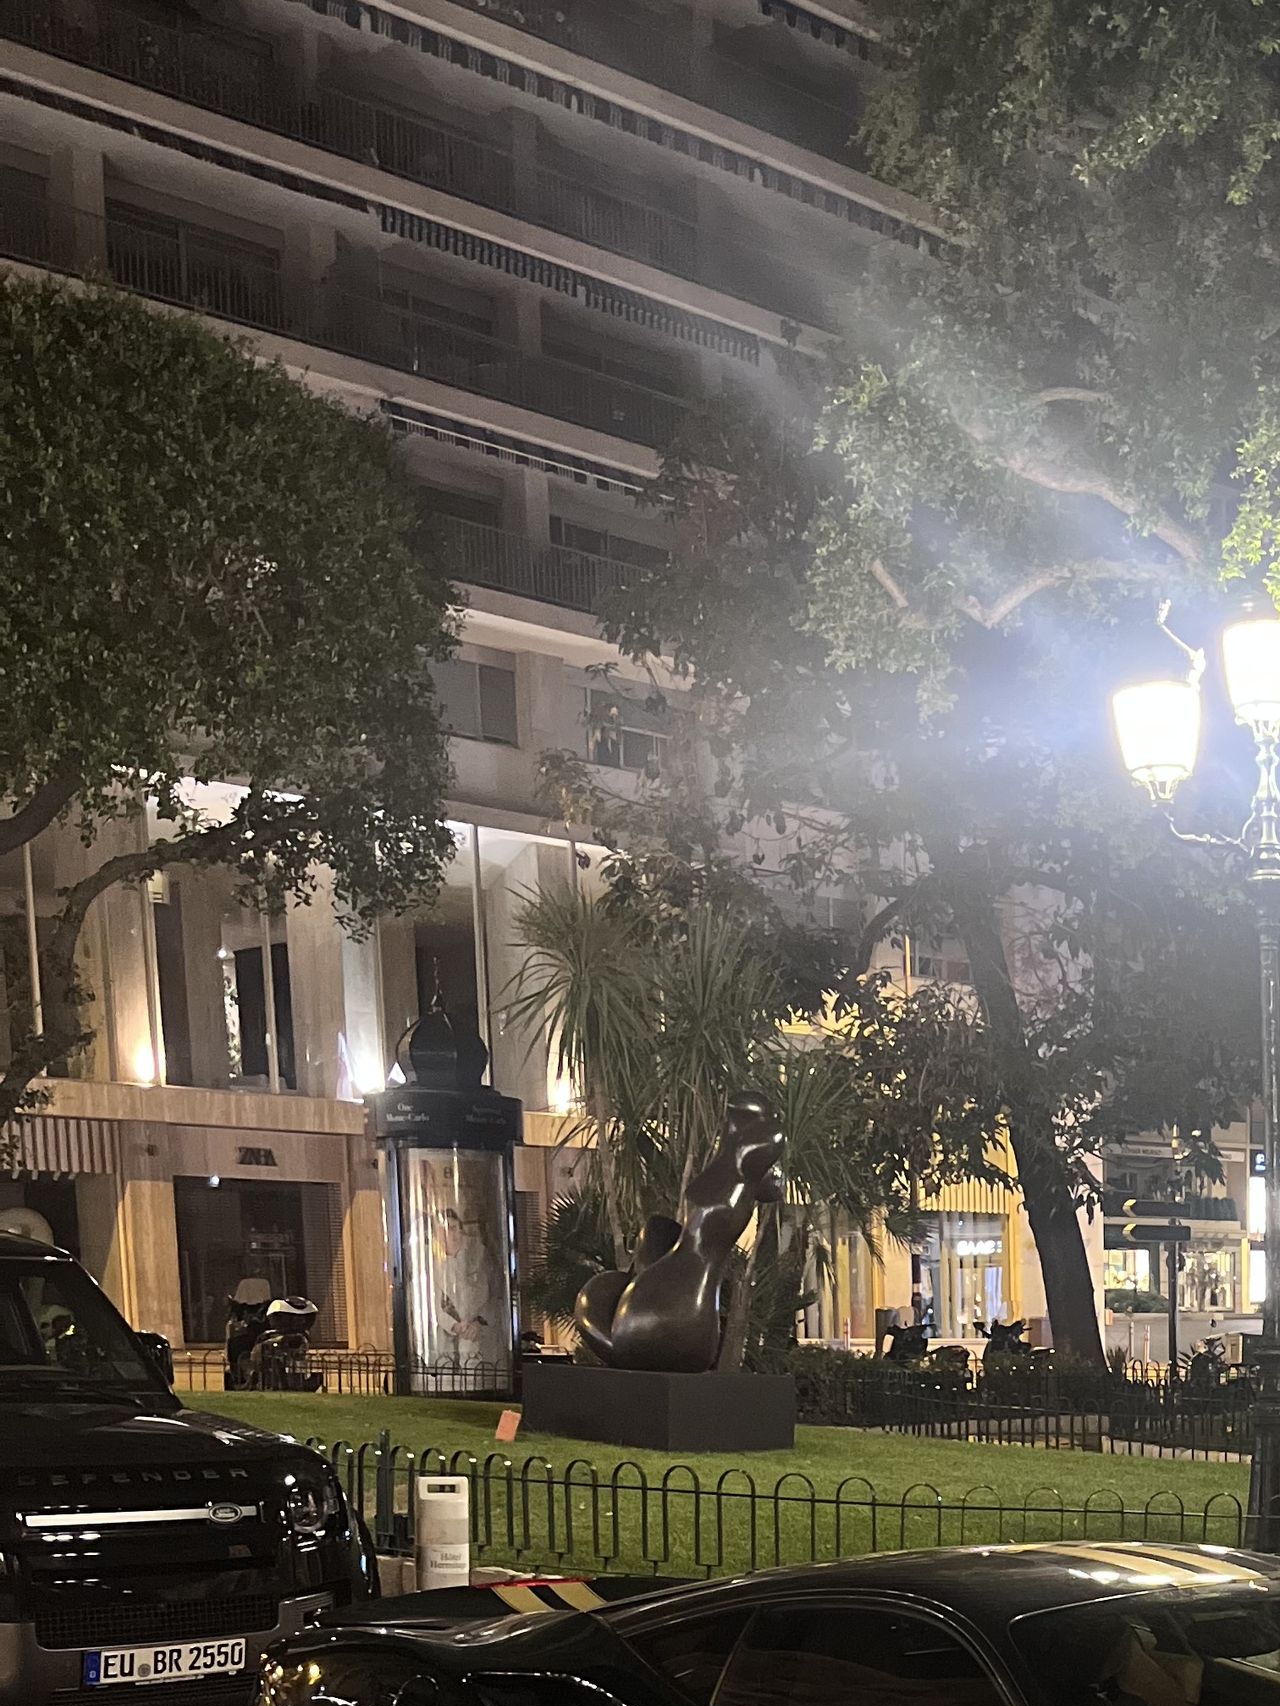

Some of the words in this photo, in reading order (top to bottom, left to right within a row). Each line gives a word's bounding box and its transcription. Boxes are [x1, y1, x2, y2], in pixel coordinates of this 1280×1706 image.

[237, 1147, 277, 1166] ZARA
[17, 1468, 249, 1486] DEFENDER
[103, 1652, 135, 1678] EU
[153, 1649, 182, 1674] BR
[189, 1642, 243, 1670] 2550
